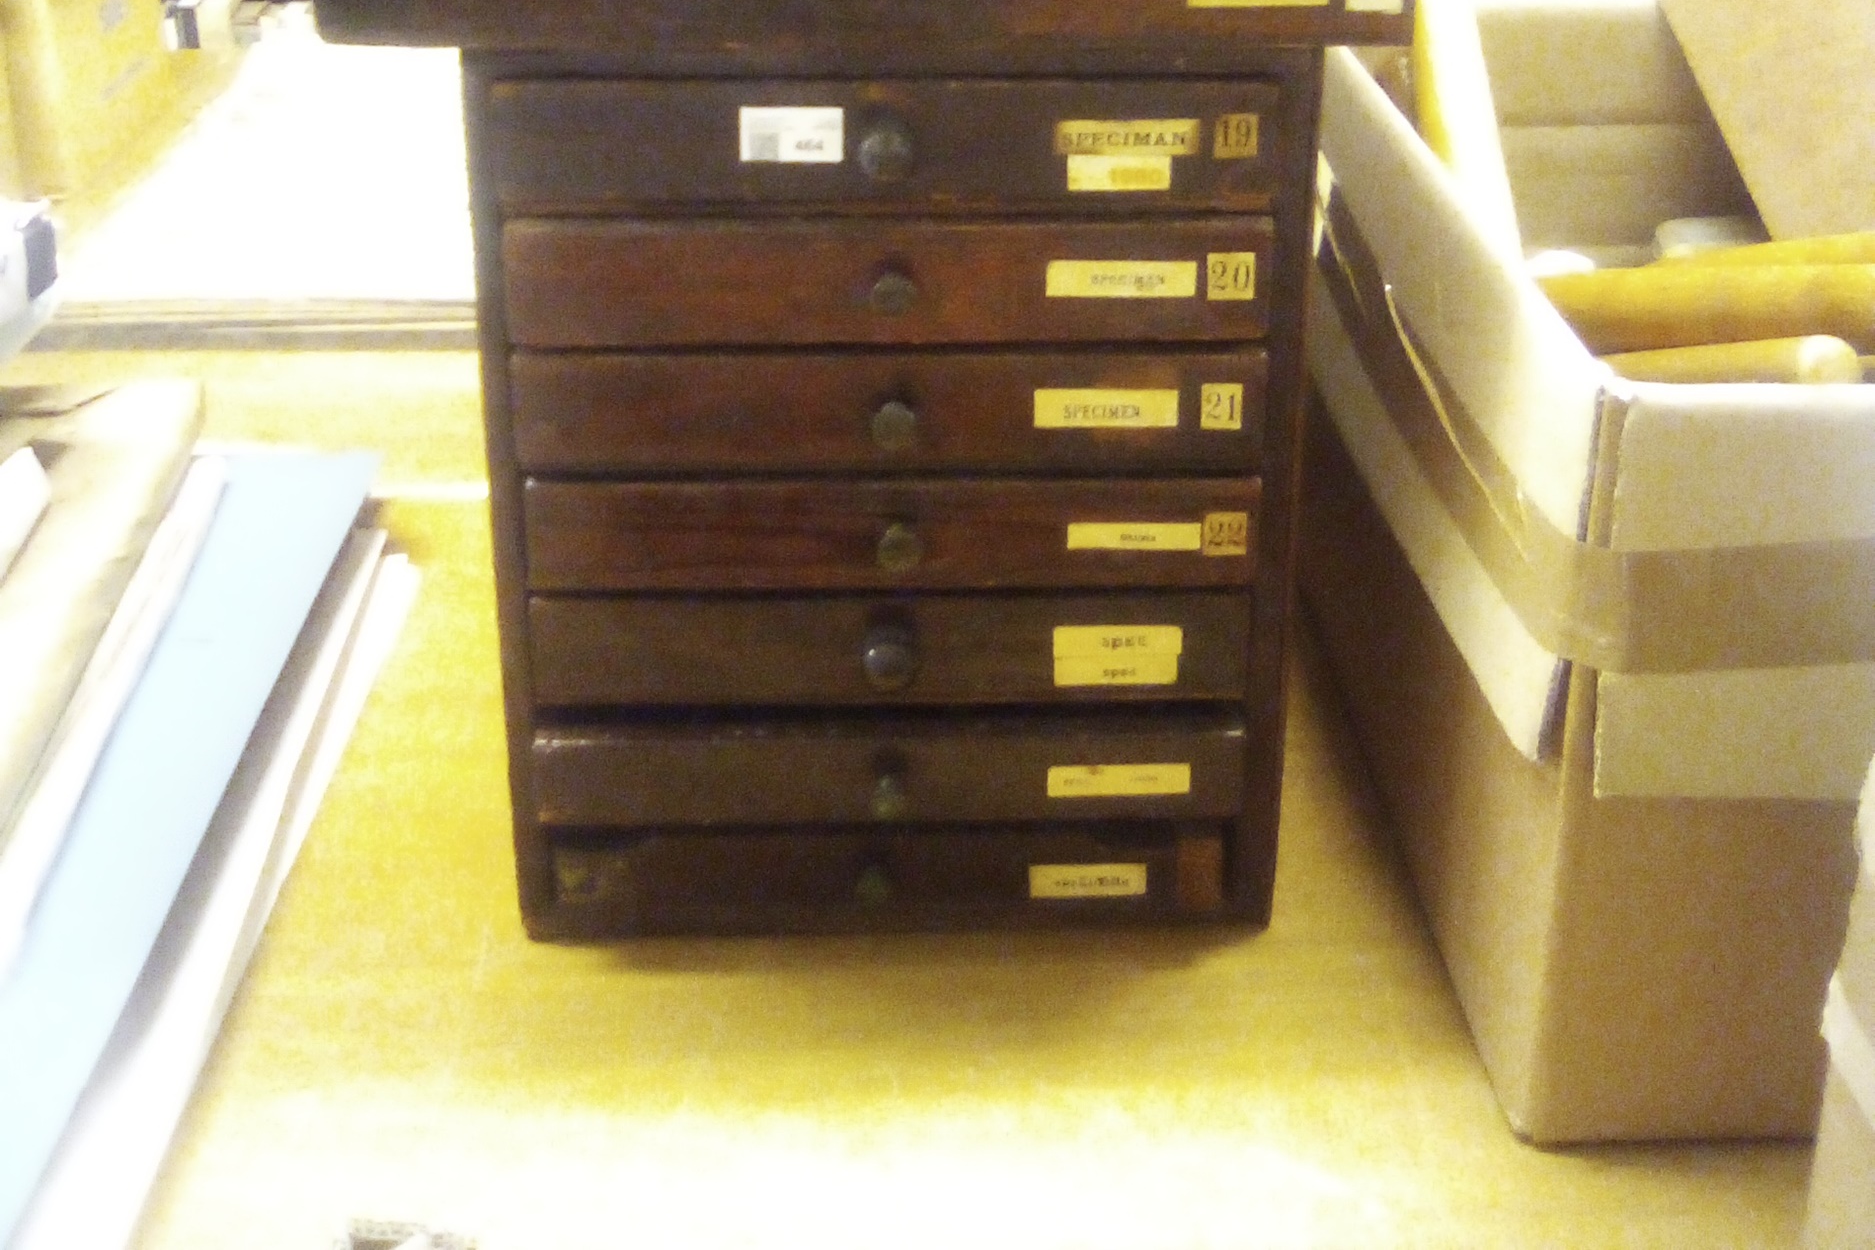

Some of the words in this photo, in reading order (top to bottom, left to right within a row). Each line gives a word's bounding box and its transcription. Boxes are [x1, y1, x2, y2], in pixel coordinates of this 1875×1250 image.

[1062, 131, 1187, 148] SPECIMAN
[1219, 118, 1252, 148] 19
[1210, 260, 1252, 292] 20
[1062, 404, 1141, 420] SPECIMEN
[1205, 392, 1238, 423] 21
[1207, 521, 1244, 548] 22
